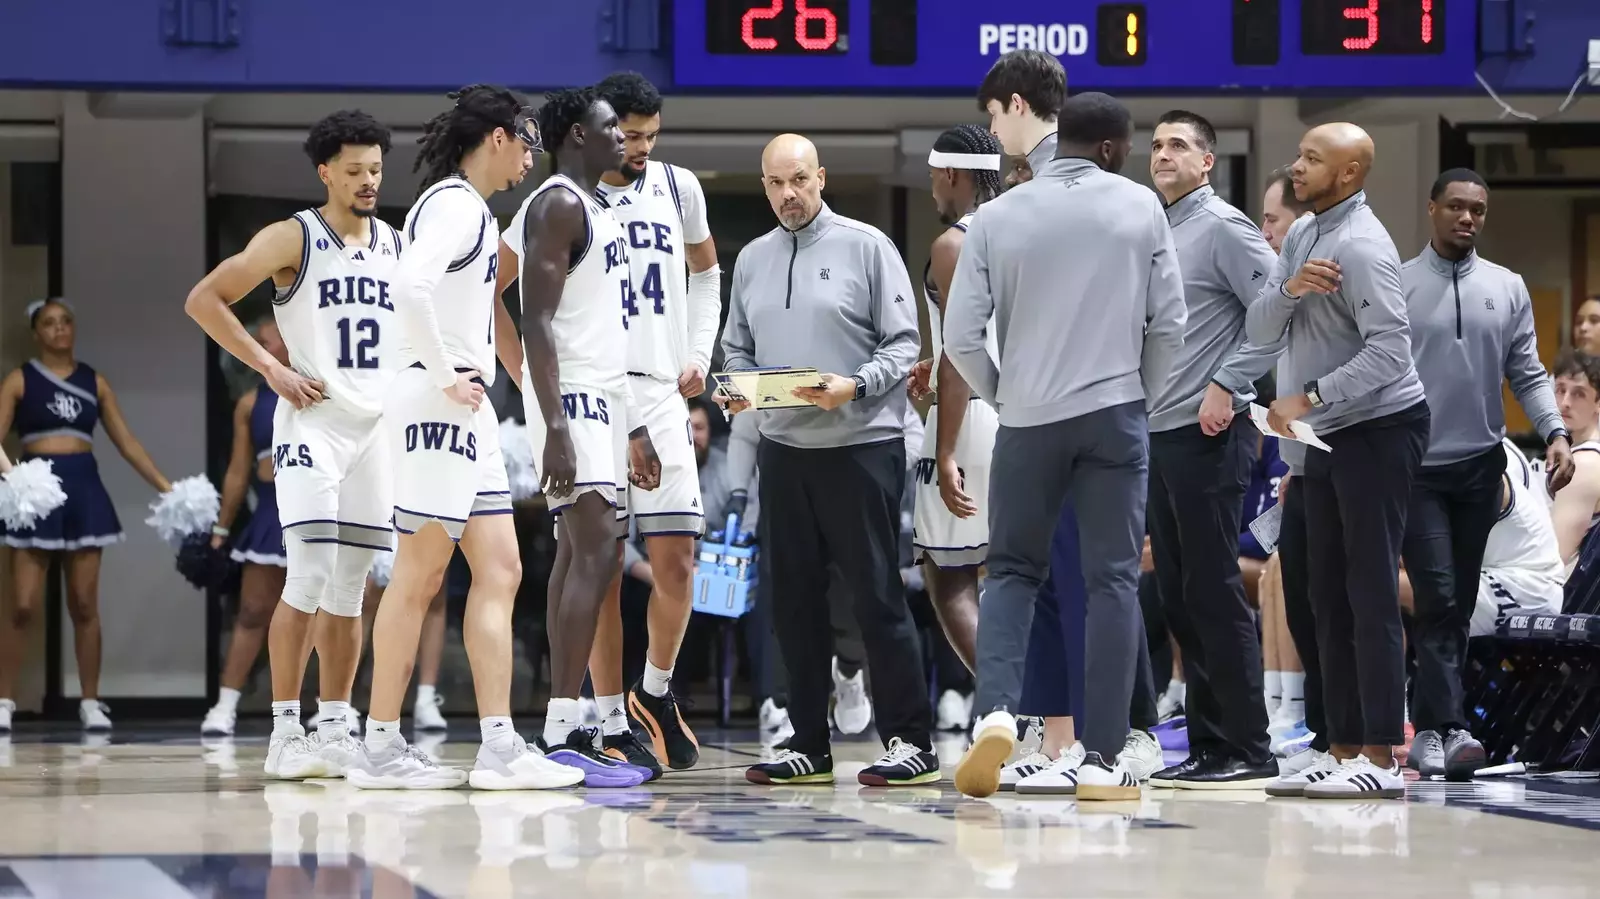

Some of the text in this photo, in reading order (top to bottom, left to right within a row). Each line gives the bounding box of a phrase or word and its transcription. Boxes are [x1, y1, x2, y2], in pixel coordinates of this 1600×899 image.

[979, 13, 1138, 56] PERIOD 1
[604, 236, 629, 273] RIC
[628, 221, 673, 255] CE
[318, 276, 395, 312] RICE
[337, 317, 380, 369] 12
[561, 393, 609, 425] WLS
[405, 422, 477, 461] OWLS
